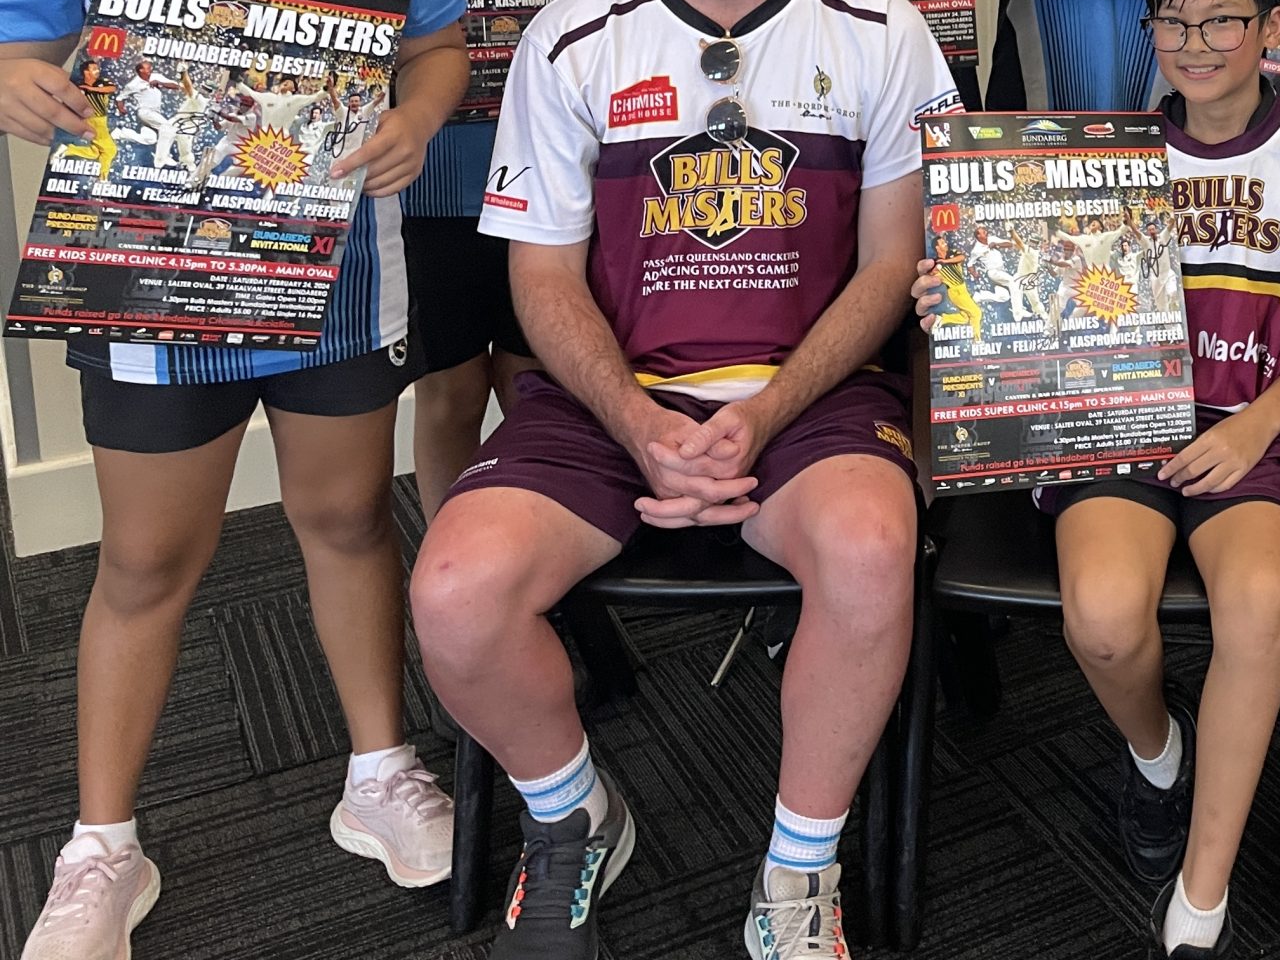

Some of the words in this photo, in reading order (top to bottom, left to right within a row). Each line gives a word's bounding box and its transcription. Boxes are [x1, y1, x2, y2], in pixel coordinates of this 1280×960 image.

[242, 3, 396, 58] MASTERS
[142, 35, 270, 71] BUNDABERG'S
[271, 54, 326, 79] BEST!!
[797, 102, 829, 112] BORDR
[1021, 134, 1067, 142] BUNDABERG
[50, 158, 101, 176] MAHER
[122, 165, 188, 185] LEHMANN
[207, 175, 255, 191] DAWES
[275, 181, 355, 201] RACKEMANN
[669, 147, 785, 194] BULLS
[929, 160, 1014, 195] BULLS
[1044, 156, 1166, 189] MASTERS
[46, 178, 80, 194] DALE
[91, 183, 130, 198] HEALY
[211, 194, 292, 214] KASPROWICZ
[303, 203, 349, 219] PFEFFER
[974, 199, 1074, 221] BUNDABERG'S
[1077, 198, 1119, 216] BEST!!
[1172, 175, 1264, 214] BULLS
[249, 239, 309, 252] INVITATIONAL
[310, 235, 334, 254] XI
[686, 252, 753, 263] QUEENSLAND
[27, 247, 56, 258] FREE
[57, 249, 87, 260] KIDS
[88, 251, 126, 263] SUPER
[127, 254, 167, 266] CLINIC
[166, 257, 208, 270] 4.15pm
[208, 260, 227, 270] TO
[227, 262, 268, 273] 5.30PM
[275, 265, 305, 276] MAIN
[305, 268, 335, 278] OVAL
[702, 264, 755, 276] TODAY'S
[756, 263, 790, 275] GAME
[673, 280, 697, 290] THE
[699, 279, 731, 290] NEXT
[733, 277, 799, 290] GENERATION
[934, 325, 972, 341] MAHER
[991, 320, 1043, 336] LEHMANN
[1061, 316, 1099, 331] DAWES
[1117, 310, 1182, 326] RACKEMANN
[935, 345, 960, 359] DALE
[971, 342, 1001, 356] HEALY
[1070, 332, 1136, 348] KASPROWICZ
[1146, 328, 1183, 342] PFEFFER
[1112, 369, 1162, 381] INVITATIONAL
[1162, 358, 1181, 376] XI
[937, 410, 958, 422] FREE
[960, 408, 982, 419] KIDS
[985, 405, 1014, 416] SUPER
[1017, 402, 1048, 413] CLINIC
[1049, 399, 1082, 412] 4.15pm
[1084, 398, 1098, 407] TO
[1100, 395, 1133, 406] 5.30PM
[1140, 392, 1165, 402] MAIN
[1166, 390, 1190, 400] OVAL
